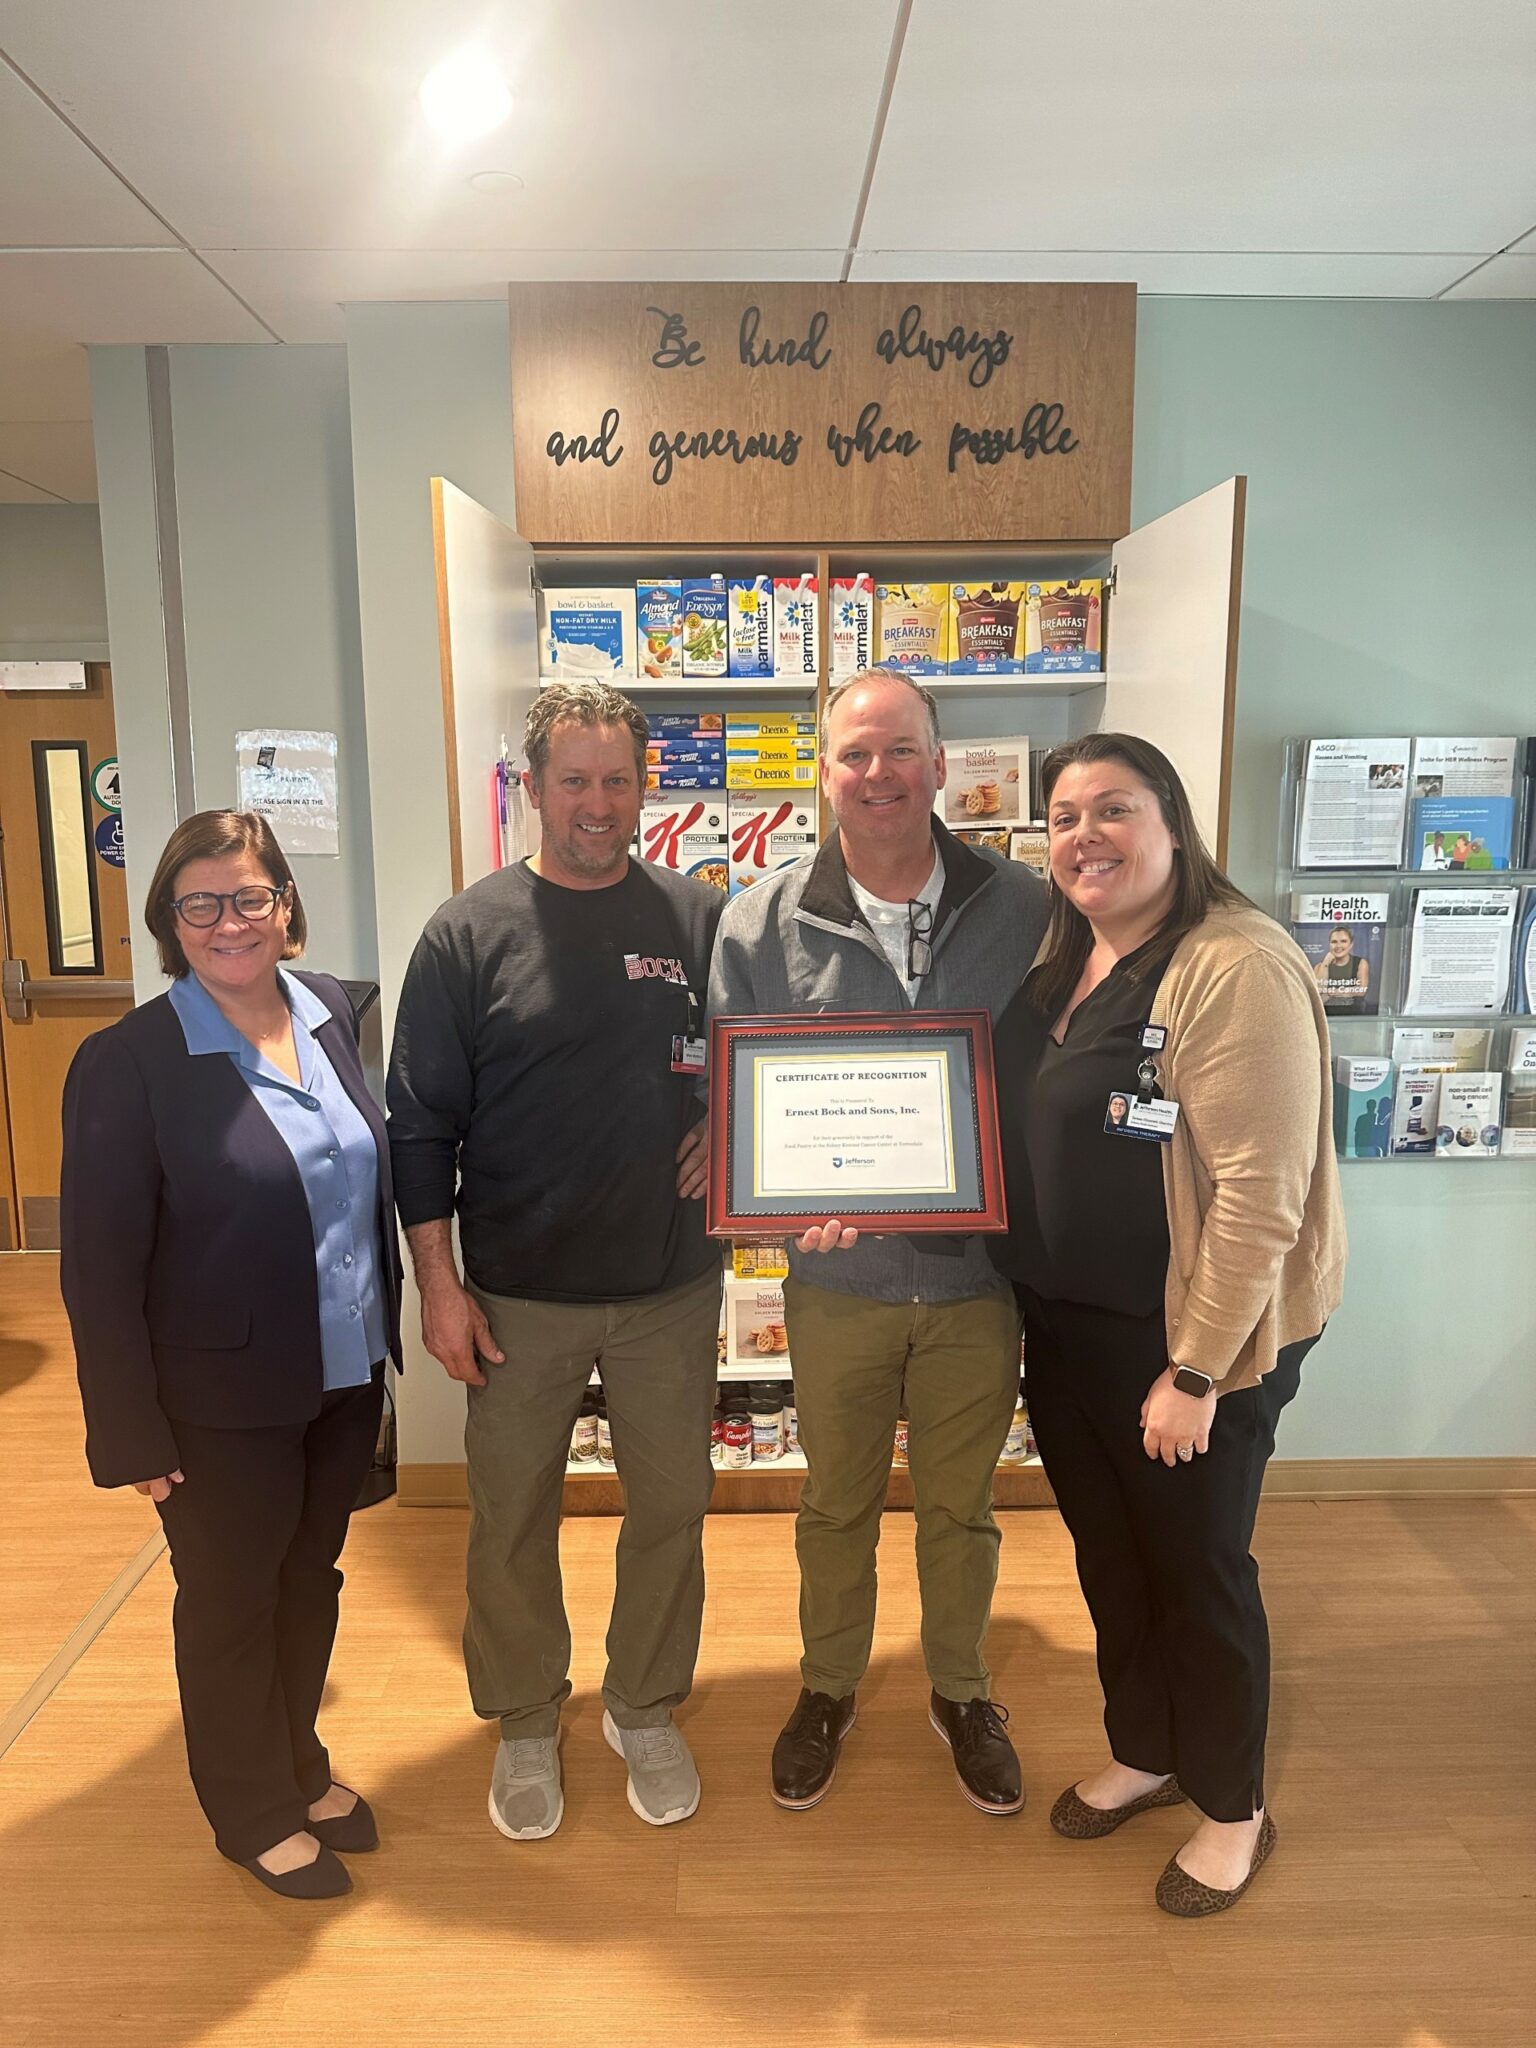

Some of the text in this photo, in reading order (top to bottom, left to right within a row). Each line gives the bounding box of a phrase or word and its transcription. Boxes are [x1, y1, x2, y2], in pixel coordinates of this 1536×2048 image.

[646, 304, 1014, 388] Be kind always
[546, 402, 1080, 486] and generous when possible
[558, 600, 577, 608] bowl
[587, 600, 614, 608] basket
[640, 600, 680, 614] Almond
[648, 611, 673, 622] Breeze
[1041, 617, 1086, 630] BREAKFAST
[733, 626, 756, 638] lactose
[742, 632, 755, 642] free
[756, 601, 770, 672] parmalat
[780, 632, 800, 640] Milk
[800, 602, 816, 673] parmalat
[834, 632, 854, 640] Milk
[884, 626, 936, 640] BREAKFAST
[961, 625, 1014, 639] BREAKFAST
[760, 725, 788, 734] Cheerios
[760, 751, 788, 760] Cheerios
[966, 749, 996, 758] bowl &
[966, 758, 996, 766] basket
[754, 768, 790, 779] Cheerios
[731, 792, 757, 802] Kellogg's
[644, 802, 705, 869] K
[732, 802, 793, 868] K
[1322, 896, 1369, 908] Health
[624, 956, 688, 981] BOCK
[776, 1074, 840, 1082] CERTIFICATE
[858, 1071, 928, 1080] RECOGNITION
[786, 1106, 920, 1117] Ernest Bock and Sons, Inc.
